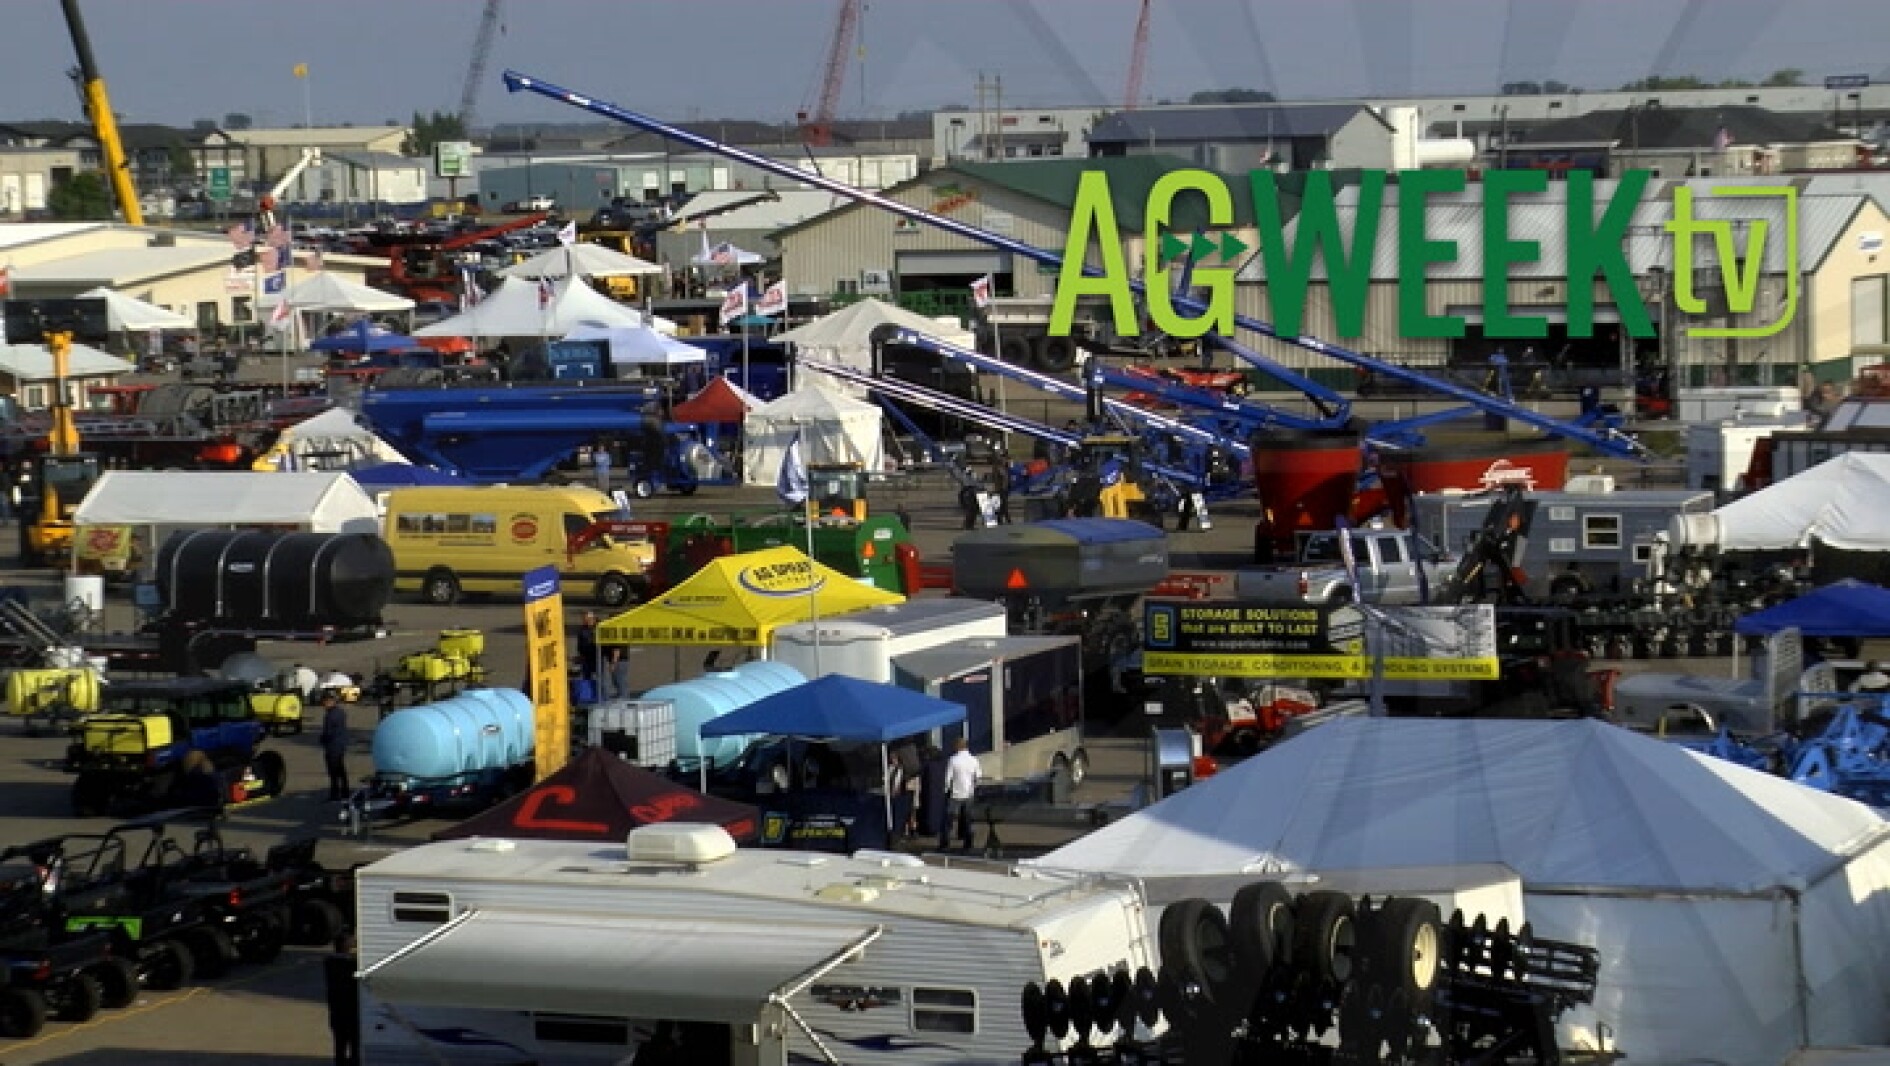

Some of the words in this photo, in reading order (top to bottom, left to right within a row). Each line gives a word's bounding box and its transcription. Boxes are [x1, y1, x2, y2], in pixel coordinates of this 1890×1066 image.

[1181, 608, 1240, 621] STORAGE
[1246, 608, 1319, 621] SOLUTIONS
[1181, 622, 1204, 634] that
[1207, 624, 1227, 634] are
[1230, 622, 1264, 634] BUILT
[1268, 622, 1285, 634] TO
[1288, 623, 1319, 635] LAST
[1149, 658, 1182, 669] GRAIN
[1365, 661, 1429, 673] HNDLING
[1433, 662, 1492, 675] SYSTEMS
